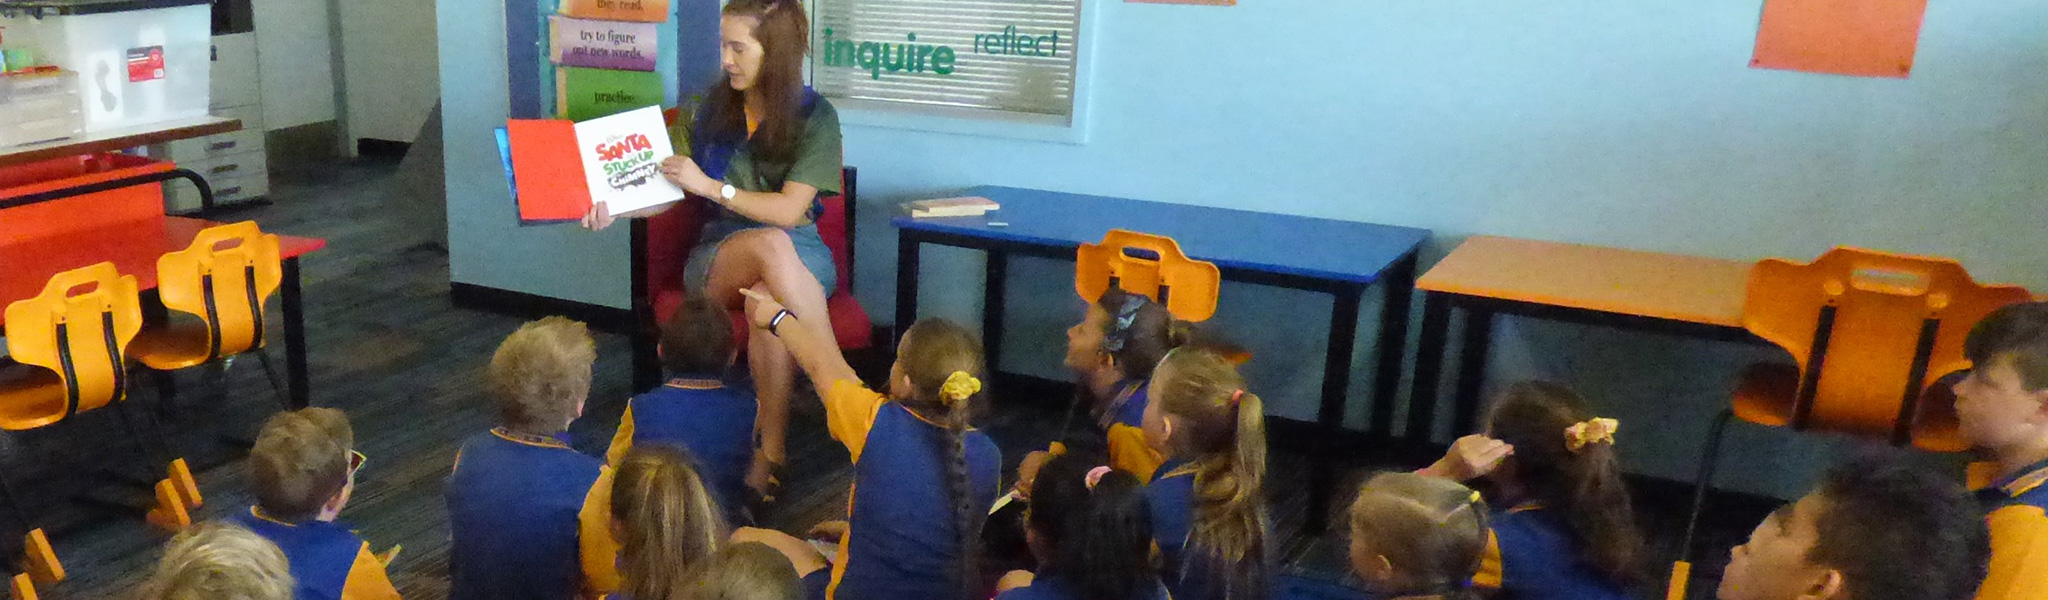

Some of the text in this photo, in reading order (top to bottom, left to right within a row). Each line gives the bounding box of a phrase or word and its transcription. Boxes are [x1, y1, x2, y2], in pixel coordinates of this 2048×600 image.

[580, 29, 636, 45] try to figure
[974, 25, 1059, 56] reflect
[573, 46, 645, 59] out new words.
[823, 27, 956, 80] inquire
[595, 133, 652, 161] SANTA
[603, 150, 654, 175] STUCK UP
[610, 163, 656, 188] CHIMNEY
